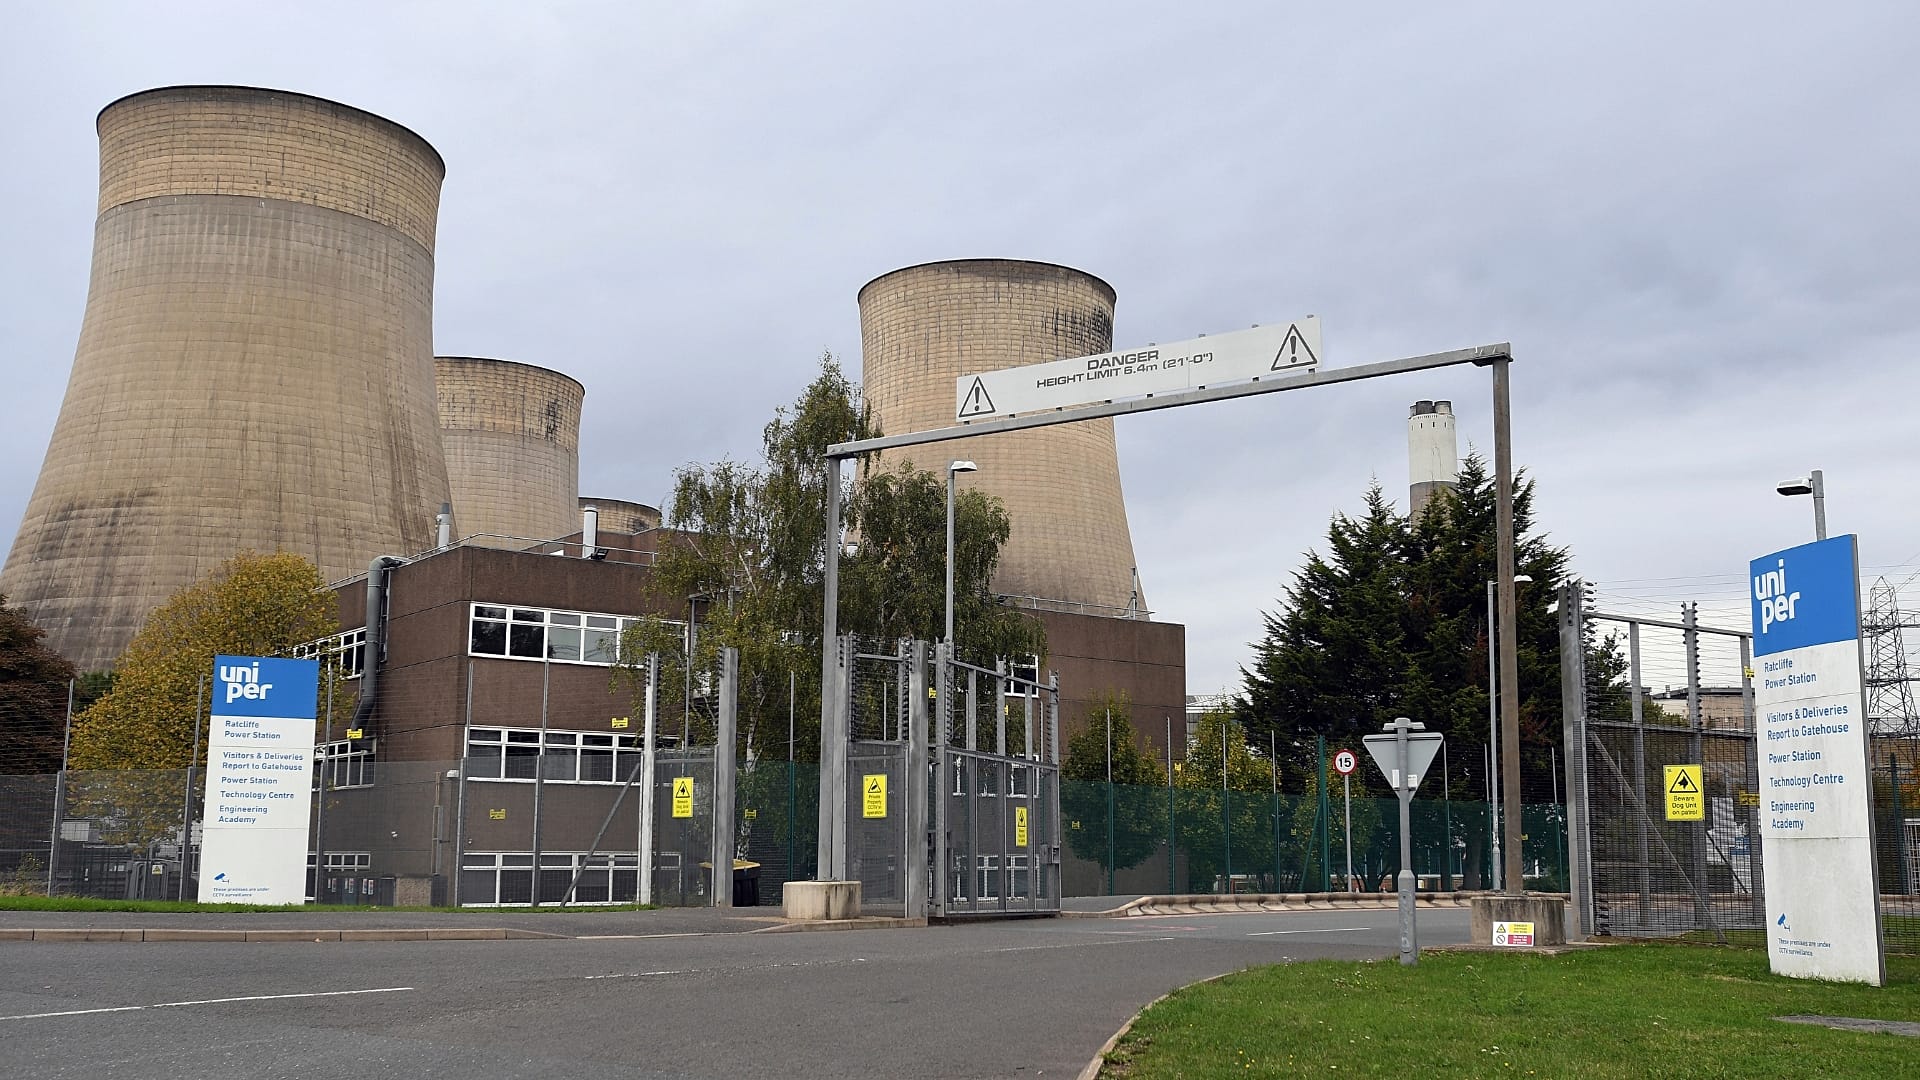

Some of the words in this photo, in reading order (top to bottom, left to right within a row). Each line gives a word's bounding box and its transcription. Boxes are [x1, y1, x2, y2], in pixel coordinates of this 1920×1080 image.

[1087, 350, 1159, 371] DANGER
[1036, 373, 1084, 389] HEIGHT
[1086, 367, 1121, 381] LIMIT
[1123, 363, 1158, 376] 6.4m
[1162, 352, 1213, 371] (21'-0")
[1754, 558, 1785, 601] uni
[1761, 591, 1800, 634] per
[220, 661, 260, 683] uni
[1764, 658, 1793, 673] Ratcliffe
[1765, 677, 1787, 690] Power
[1788, 672, 1817, 686] Station
[226, 682, 273, 704] per
[1766, 711, 1793, 724] Visitors
[1794, 708, 1801, 720] &
[1802, 704, 1849, 719] Deliveries
[225, 720, 260, 729] Ratcliffe
[224, 730, 251, 738] Power
[252, 731, 281, 739] Station
[1767, 729, 1791, 742] Report
[1792, 727, 1800, 738] to
[1801, 723, 1849, 737] Gatehouse
[223, 751, 254, 760] Visitors
[256, 752, 262, 760] &
[264, 752, 304, 761] Deliveries
[1338, 757, 1352, 768] 15
[1768, 753, 1790, 764] Power
[1791, 749, 1821, 762] Station
[222, 761, 250, 770] Report
[252, 762, 260, 770] to
[261, 763, 303, 771] Gatehouse
[221, 776, 247, 784] Power
[249, 777, 278, 785] Station
[1769, 775, 1811, 788] Technology
[1812, 773, 1844, 785] Centre
[220, 790, 267, 800] Technology
[268, 791, 294, 799] Centre
[219, 805, 268, 814] Engineering
[1770, 799, 1815, 813] Engineering
[218, 815, 256, 824] Academy
[1771, 818, 1804, 831] Academy
